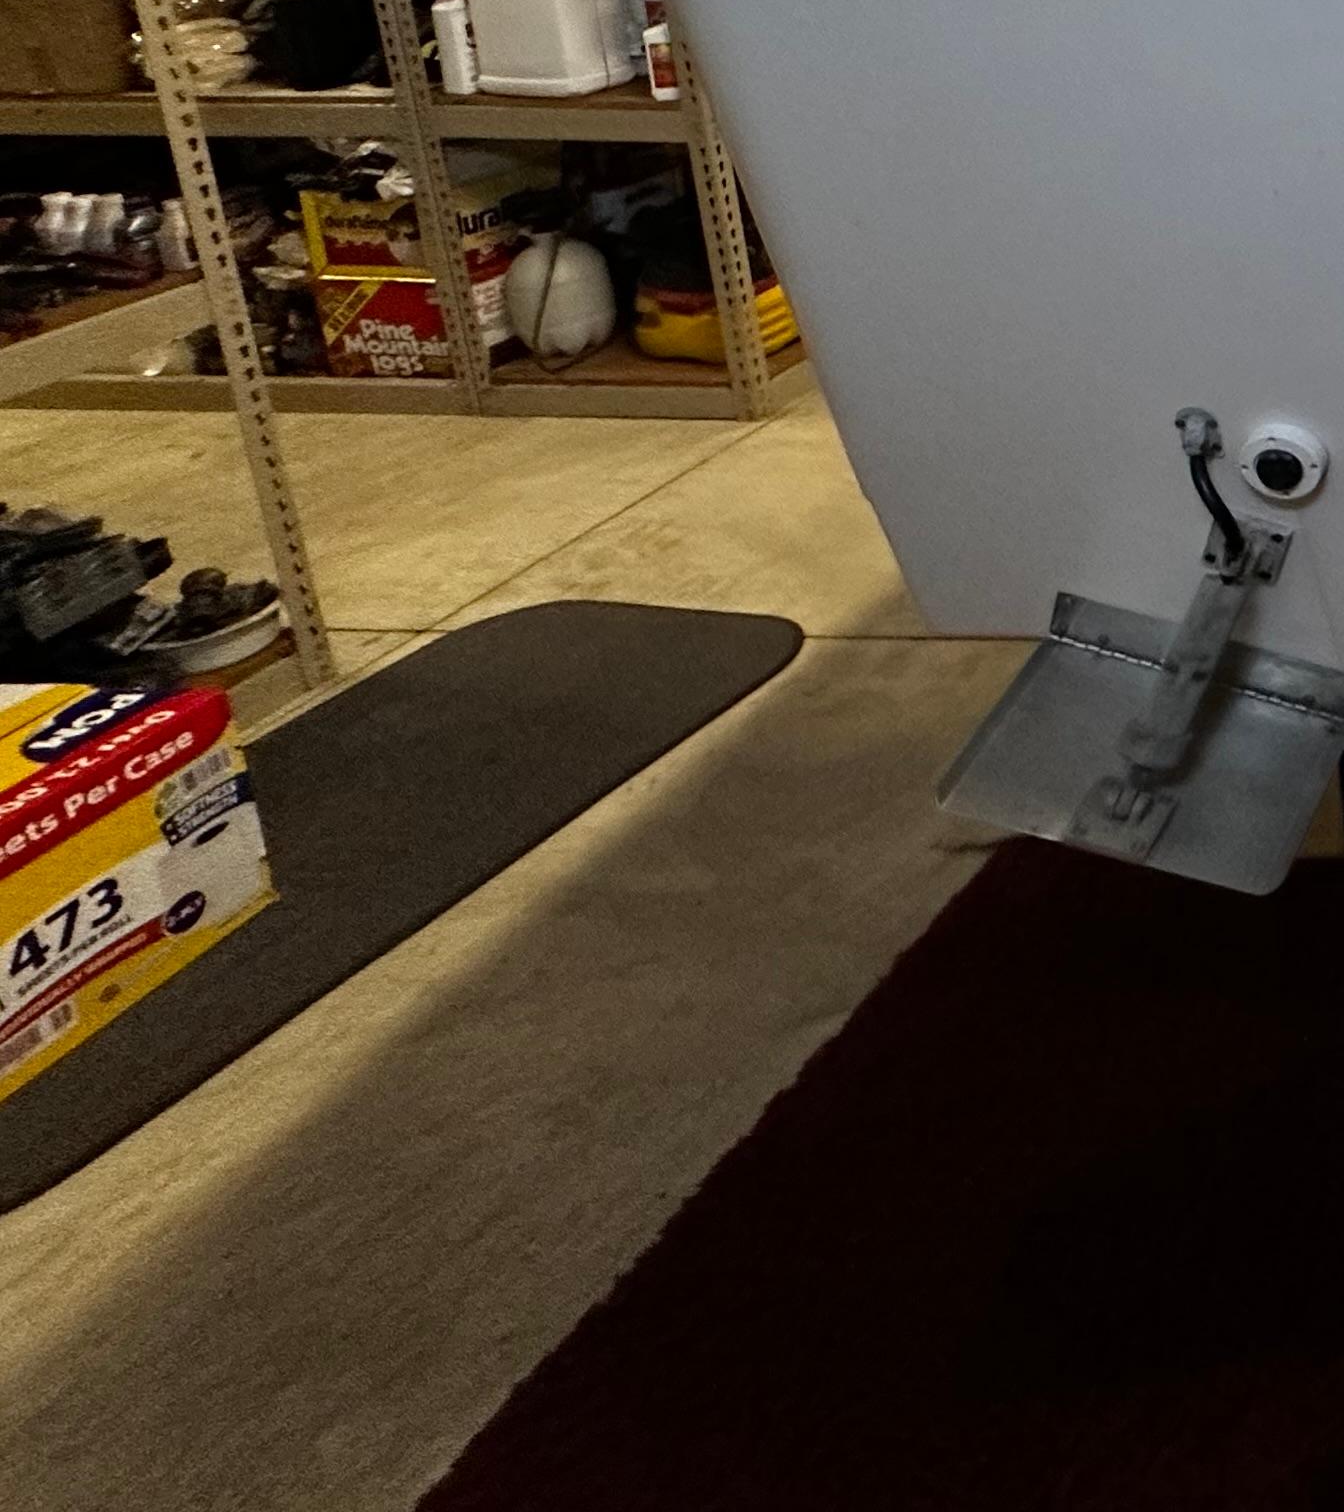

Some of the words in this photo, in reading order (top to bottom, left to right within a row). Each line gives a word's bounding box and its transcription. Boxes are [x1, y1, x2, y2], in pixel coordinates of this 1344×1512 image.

[360, 319, 415, 342] Pine
[63, 776, 119, 820] Per
[123, 730, 194, 780] Case
[9, 877, 124, 980] 473
